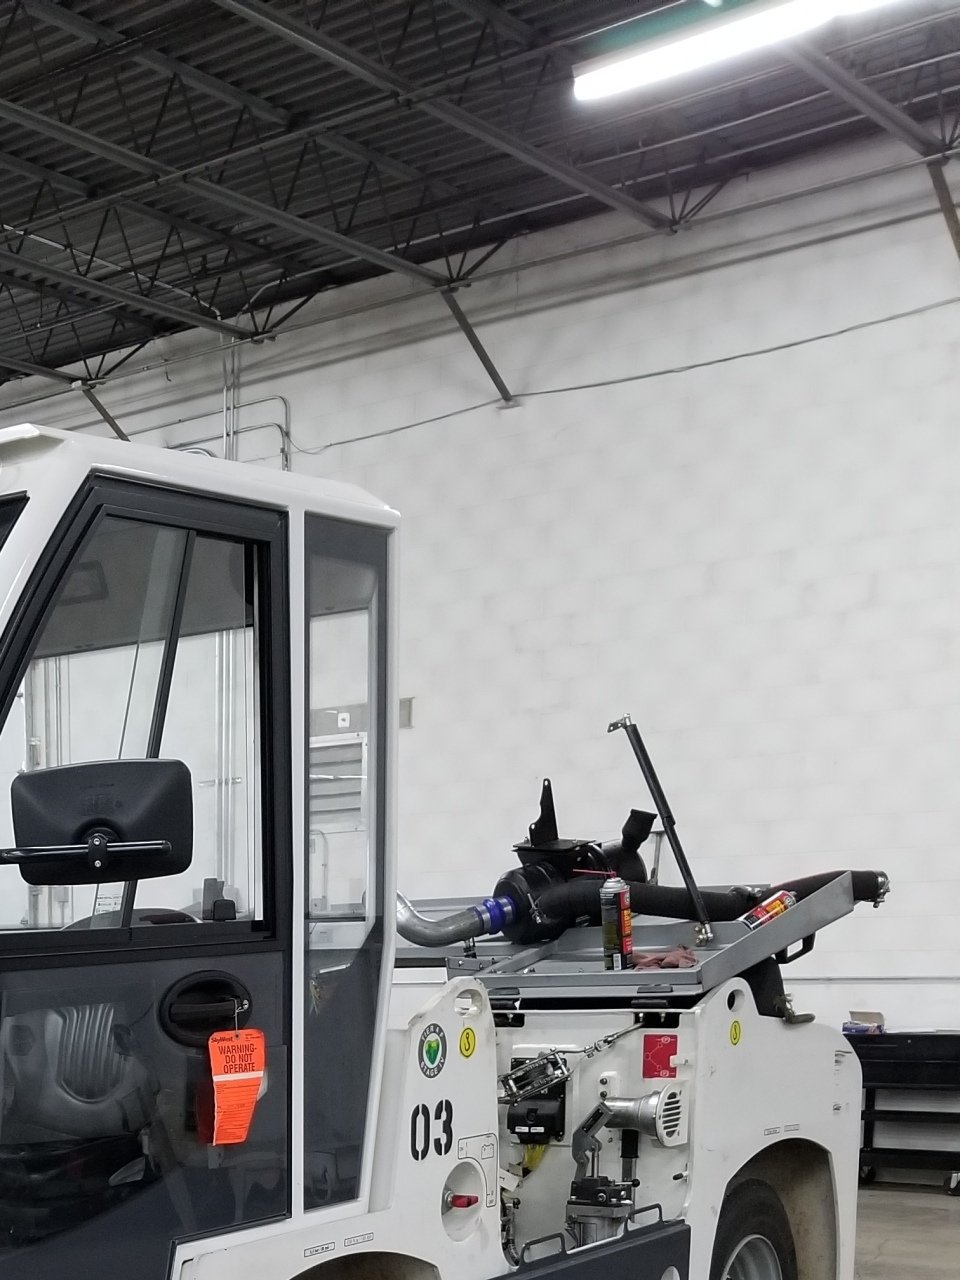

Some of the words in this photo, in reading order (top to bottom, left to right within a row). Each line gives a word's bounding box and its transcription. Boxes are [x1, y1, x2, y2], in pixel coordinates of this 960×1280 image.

[421, 1024, 434, 1041] TIER
[225, 1054, 237, 1065] DO
[238, 1053, 253, 1063] NOT
[223, 1062, 256, 1074] OPERATE
[420, 1061, 438, 1077] STAGE
[410, 1099, 453, 1161] 03
